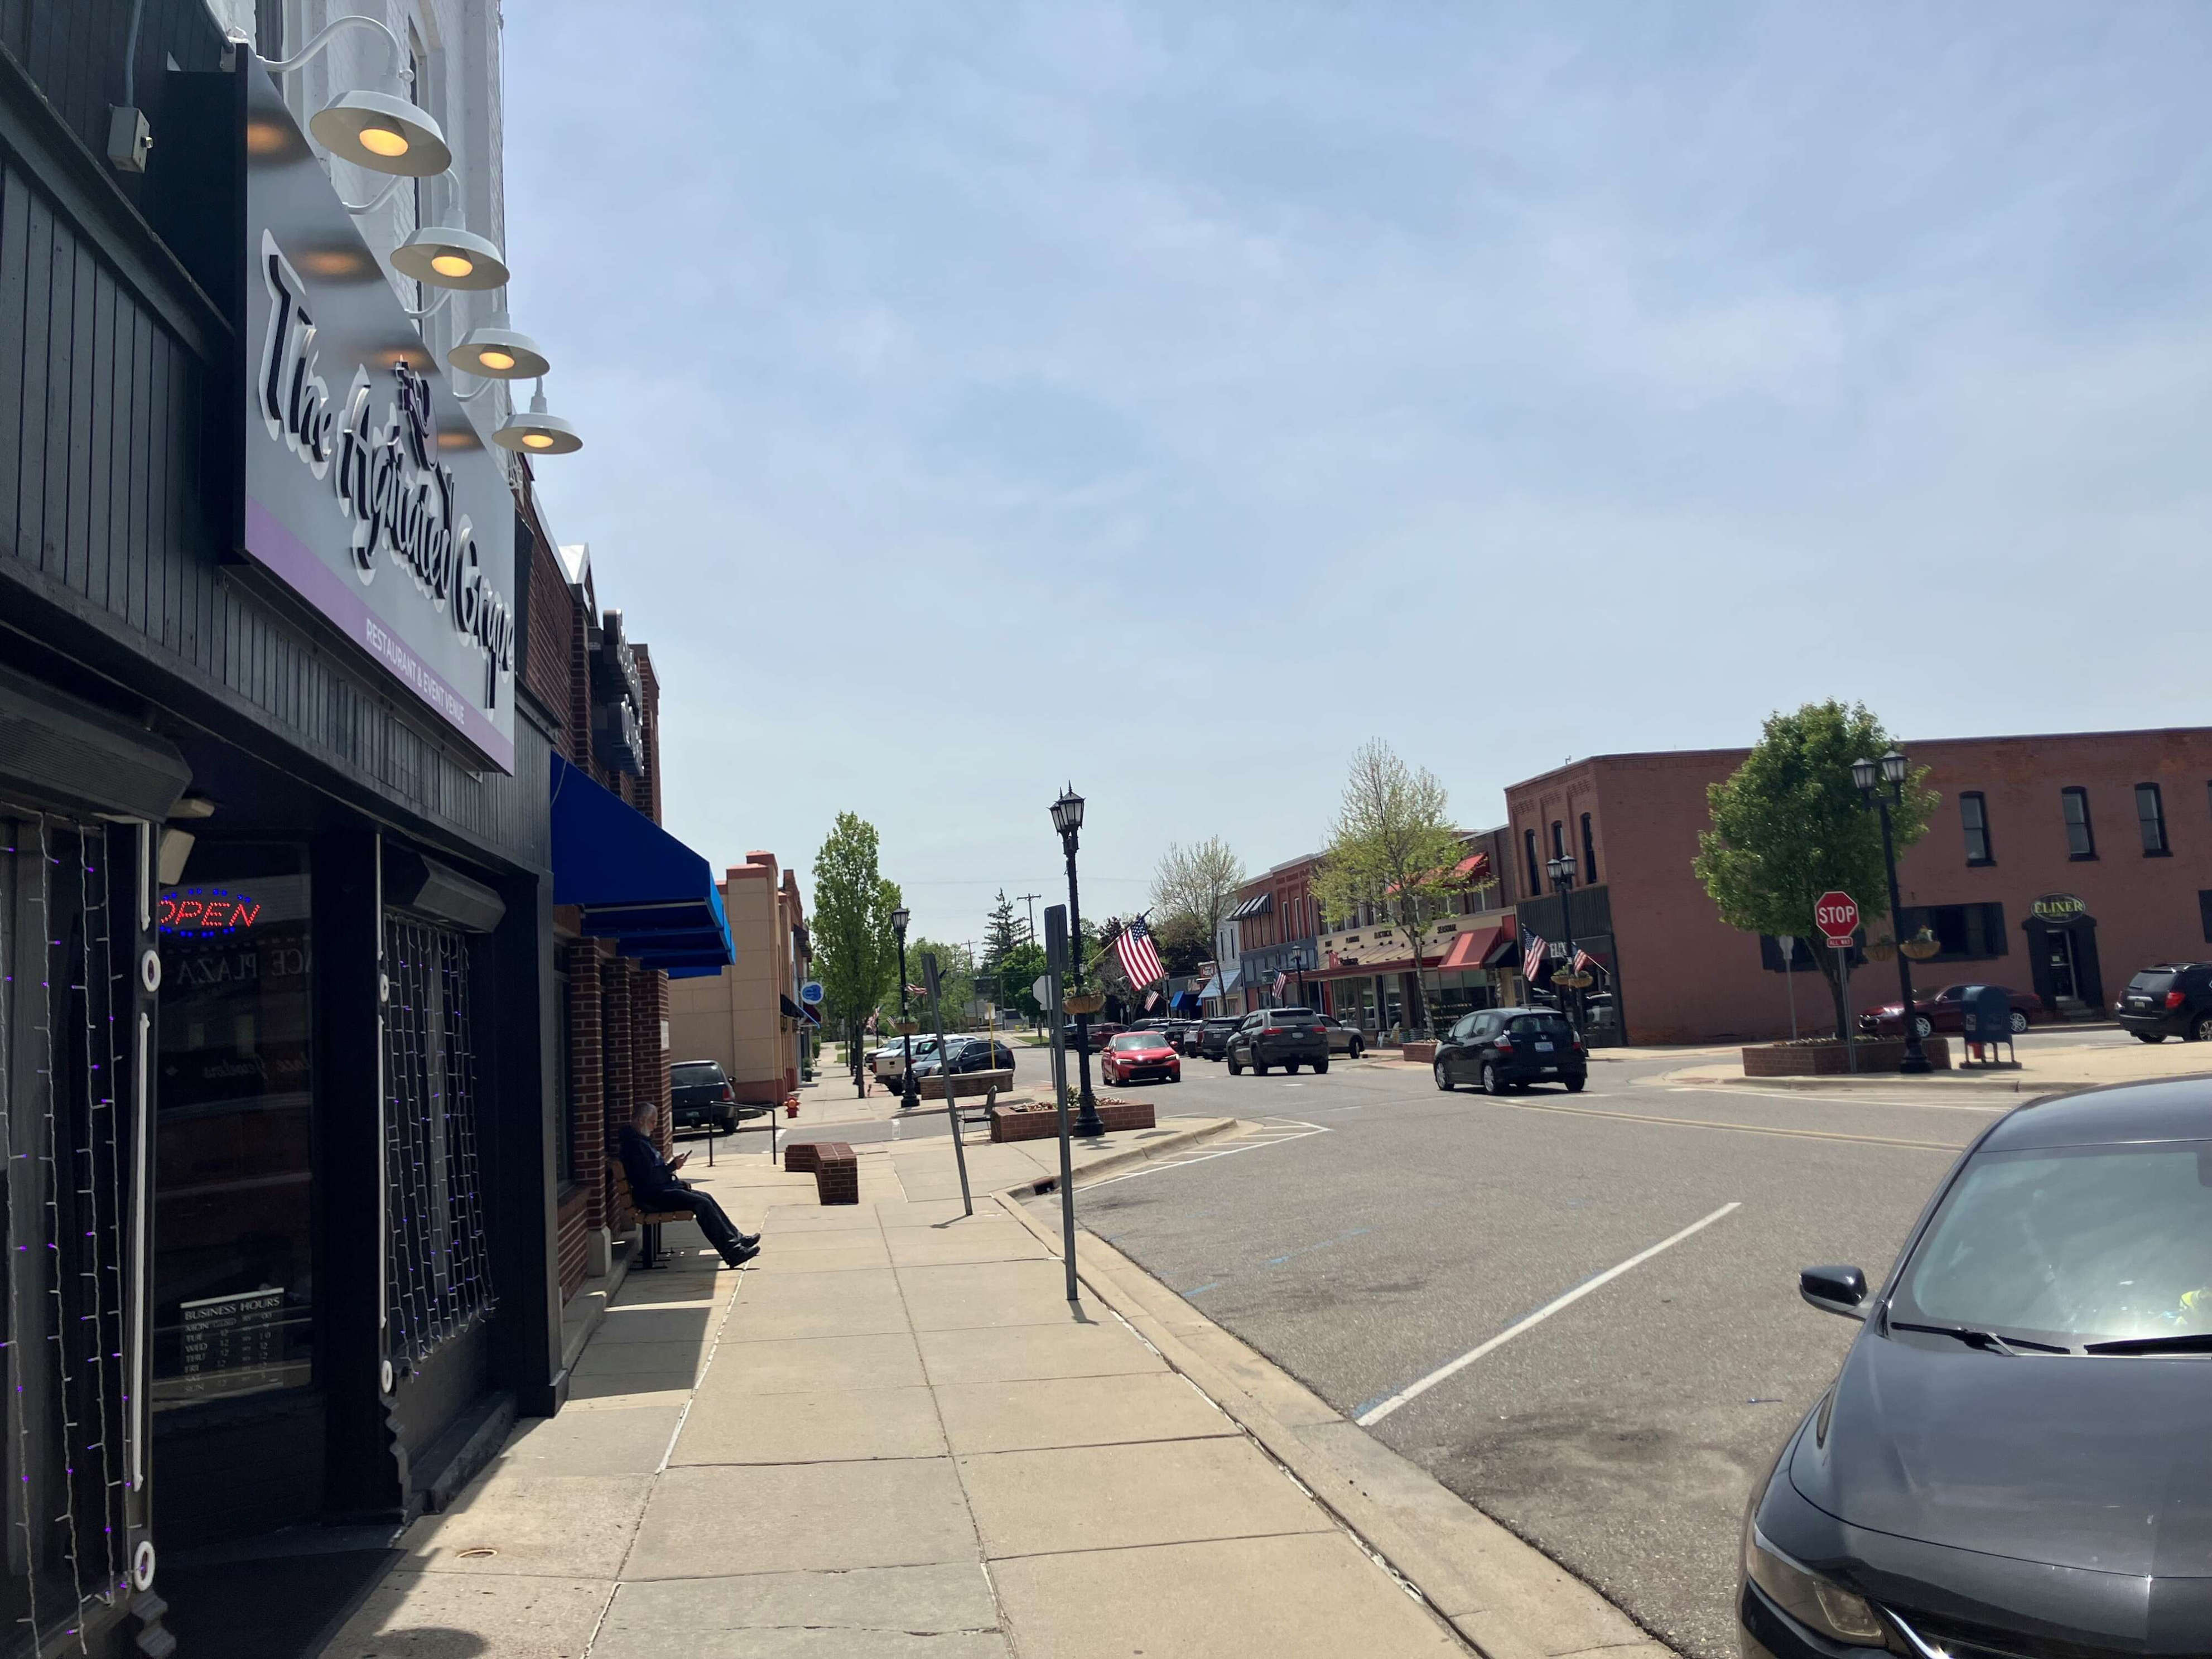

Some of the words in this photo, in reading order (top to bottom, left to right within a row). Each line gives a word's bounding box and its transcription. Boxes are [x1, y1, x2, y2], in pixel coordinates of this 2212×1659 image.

[259, 228, 332, 481] The
[335, 363, 454, 613] Agitated
[453, 513, 515, 722] Grape
[367, 618, 416, 682] RESTAURANT
[417, 667, 423, 688] &
[423, 672, 444, 707] EVENT
[446, 692, 465, 725] VENUE
[158, 900, 261, 927] OPEN
[1819, 905, 1855, 924] STOP
[2033, 901, 2084, 914] ELIXER
[185, 1304, 237, 1320] BUSINESS
[240, 1296, 280, 1311] HOURS
